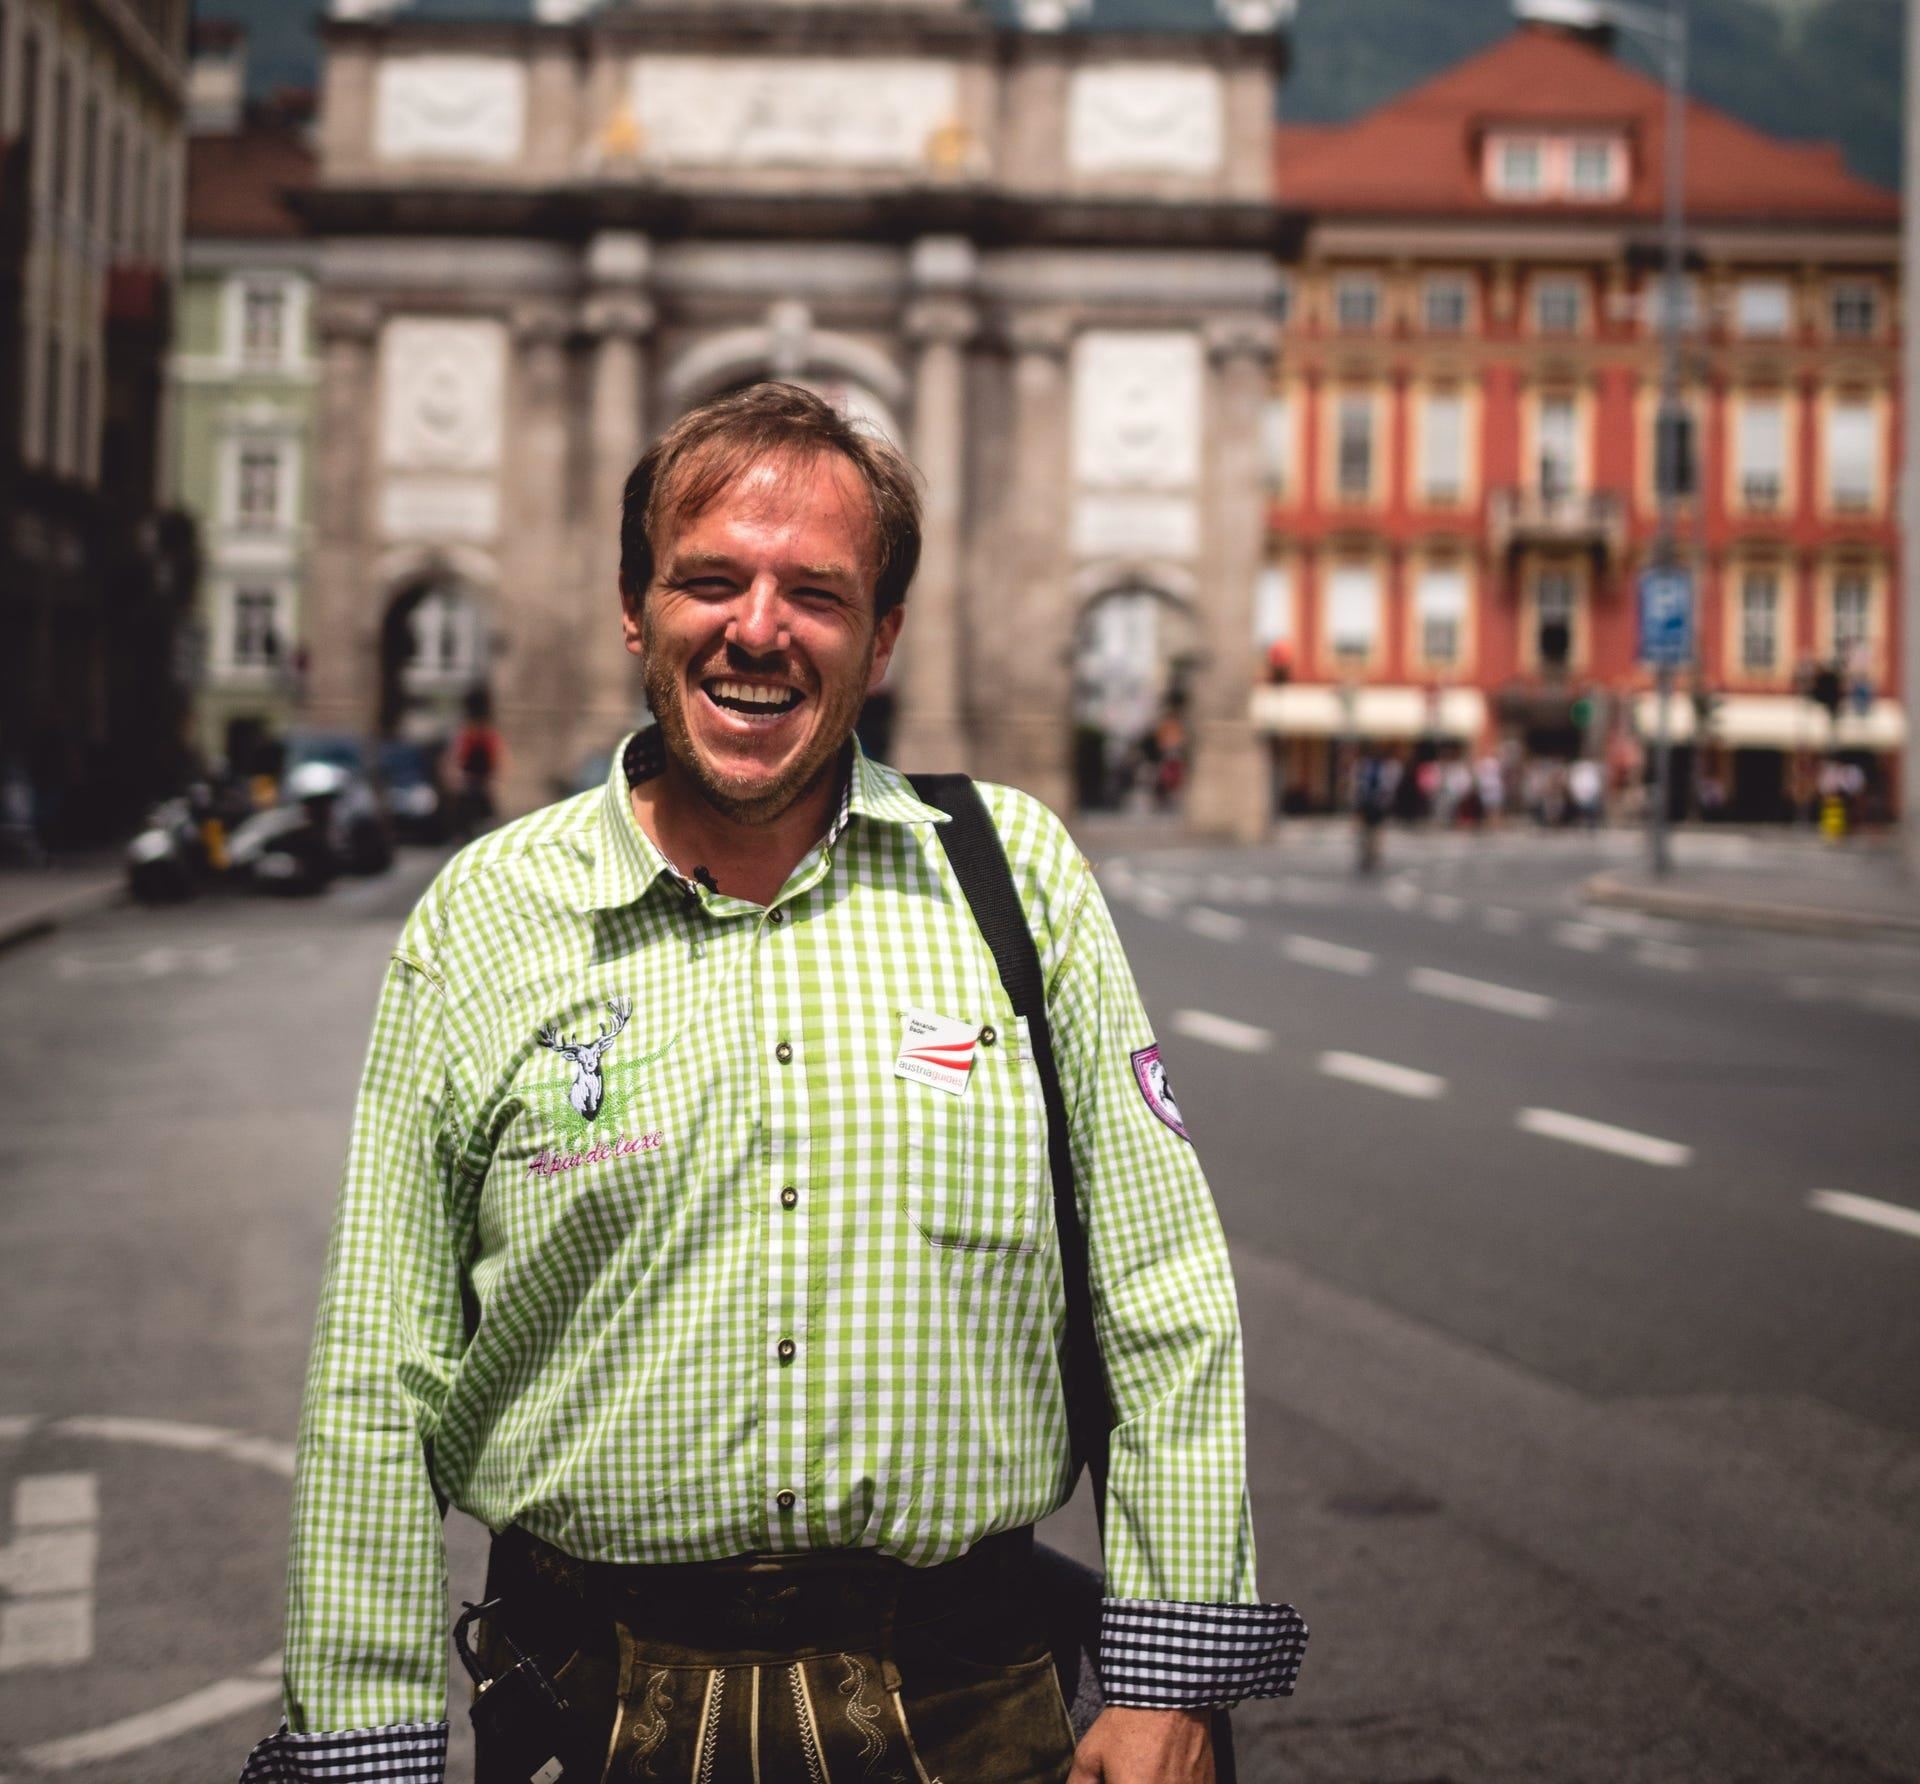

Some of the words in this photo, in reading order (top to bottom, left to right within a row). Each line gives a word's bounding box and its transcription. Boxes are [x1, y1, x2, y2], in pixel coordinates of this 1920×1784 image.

[898, 1060, 963, 1087] austriaguides
[585, 1140, 611, 1163] de
[615, 1129, 664, 1157] luxe
